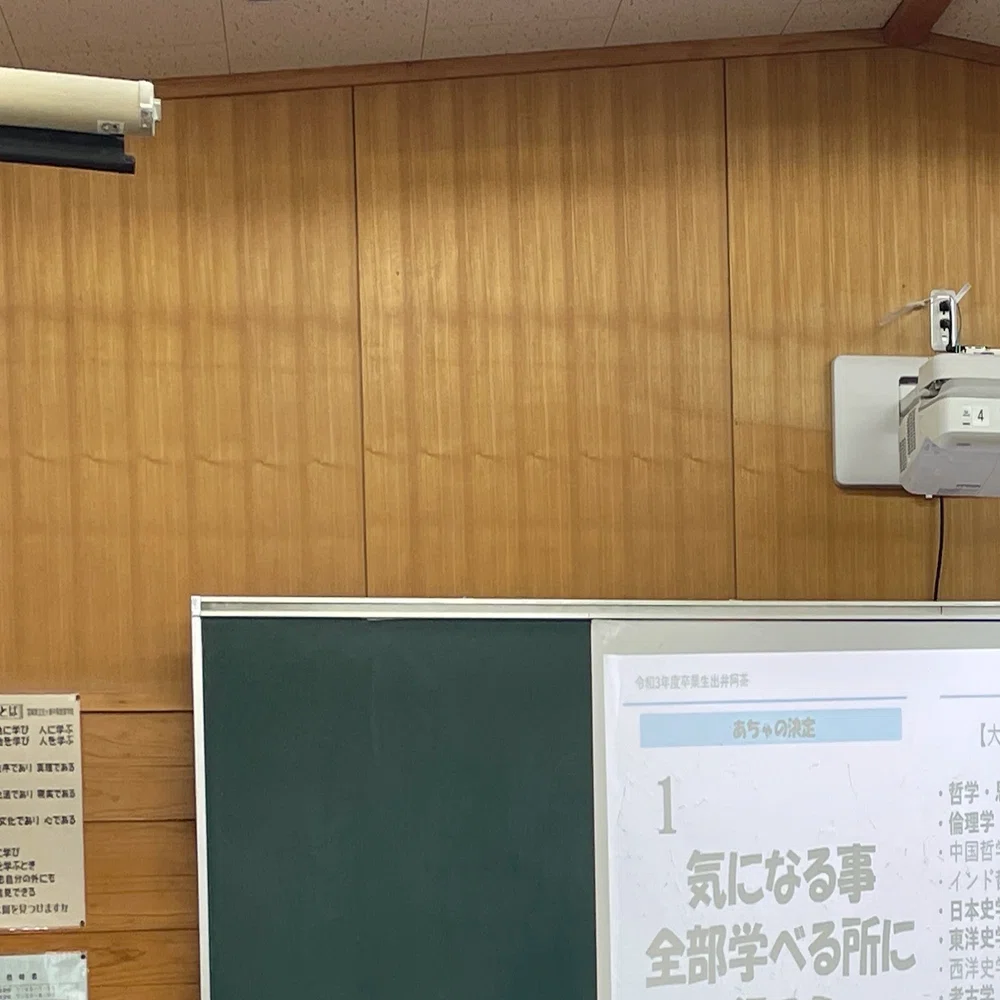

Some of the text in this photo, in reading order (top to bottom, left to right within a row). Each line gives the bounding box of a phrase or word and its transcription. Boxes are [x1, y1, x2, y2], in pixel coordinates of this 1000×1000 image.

[977, 409, 984, 421] 4
[732, 716, 817, 739] あちゃの決定
[657, 775, 677, 835] 1
[948, 810, 995, 835] 倫理学
[686, 843, 877, 910] 気になる事
[645, 915, 917, 989] 全部学べる所に
